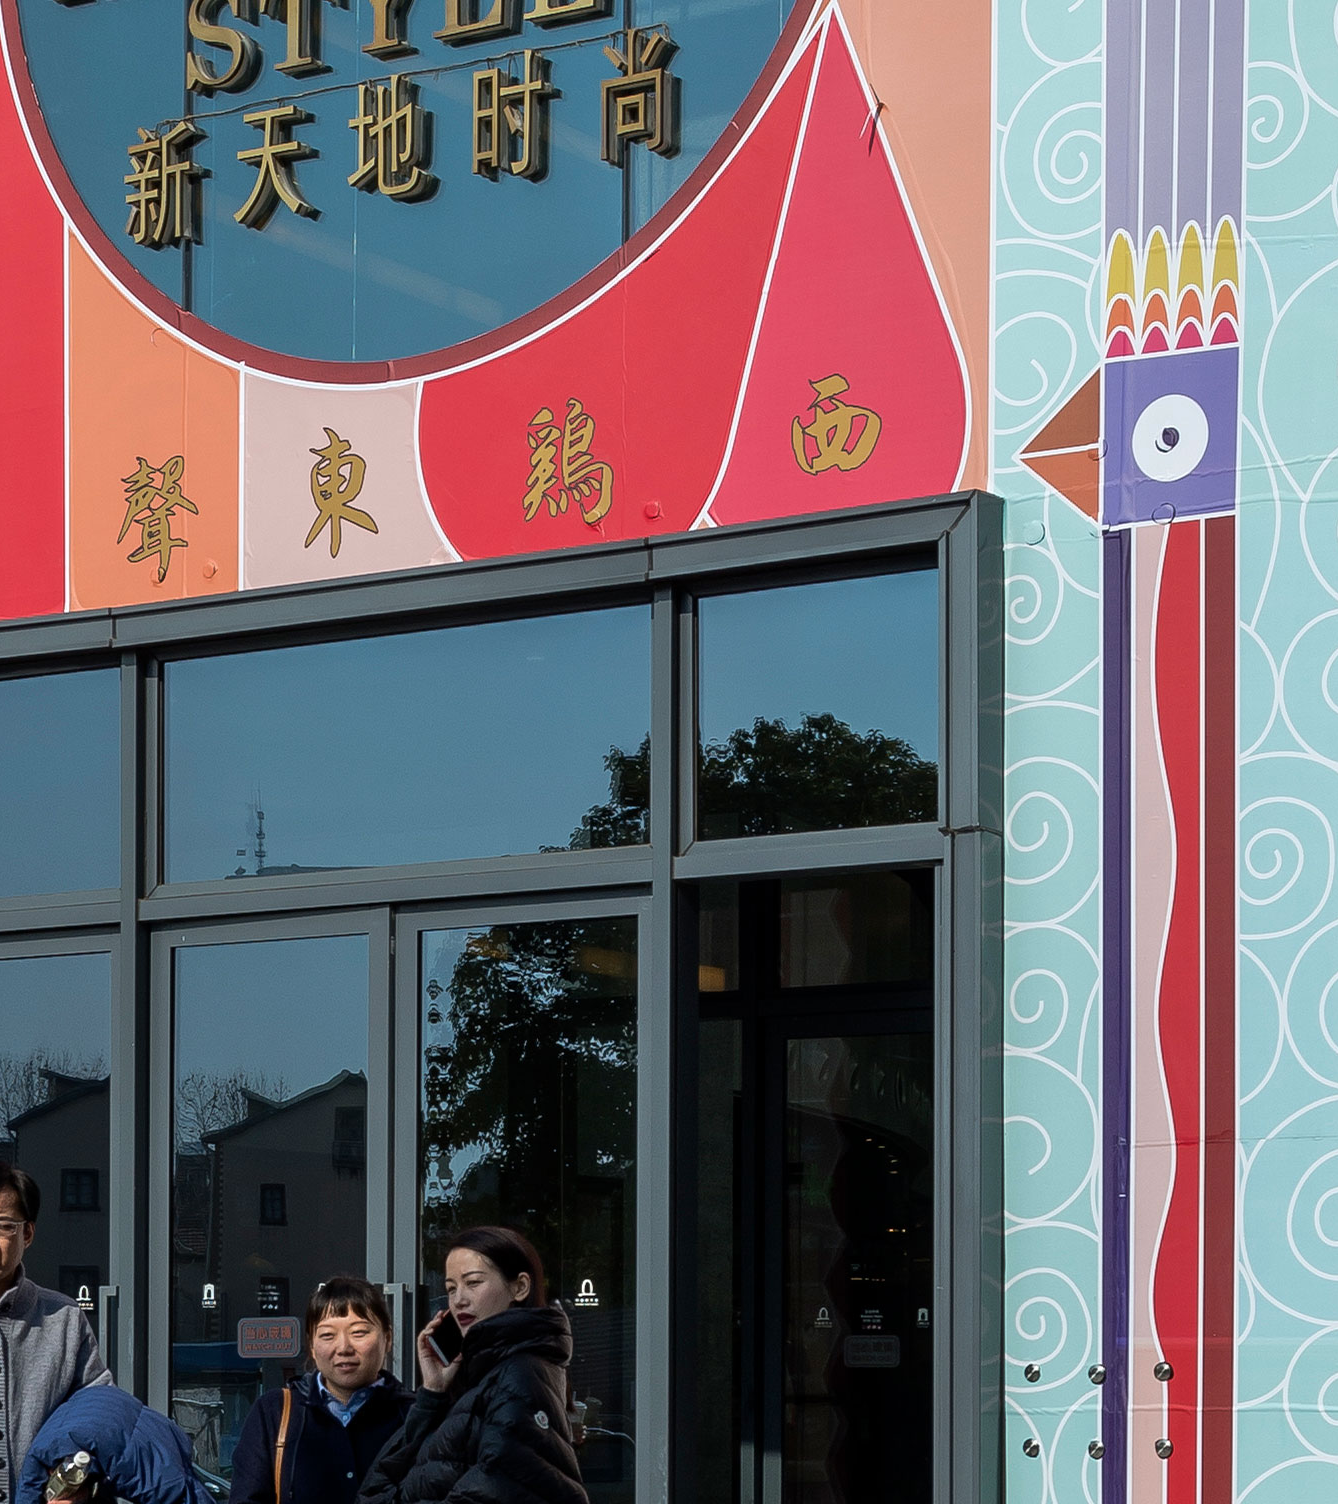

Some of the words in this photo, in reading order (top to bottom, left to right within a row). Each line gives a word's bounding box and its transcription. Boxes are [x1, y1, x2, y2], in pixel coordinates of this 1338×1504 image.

[124, 28, 681, 250] 新天地时尚
